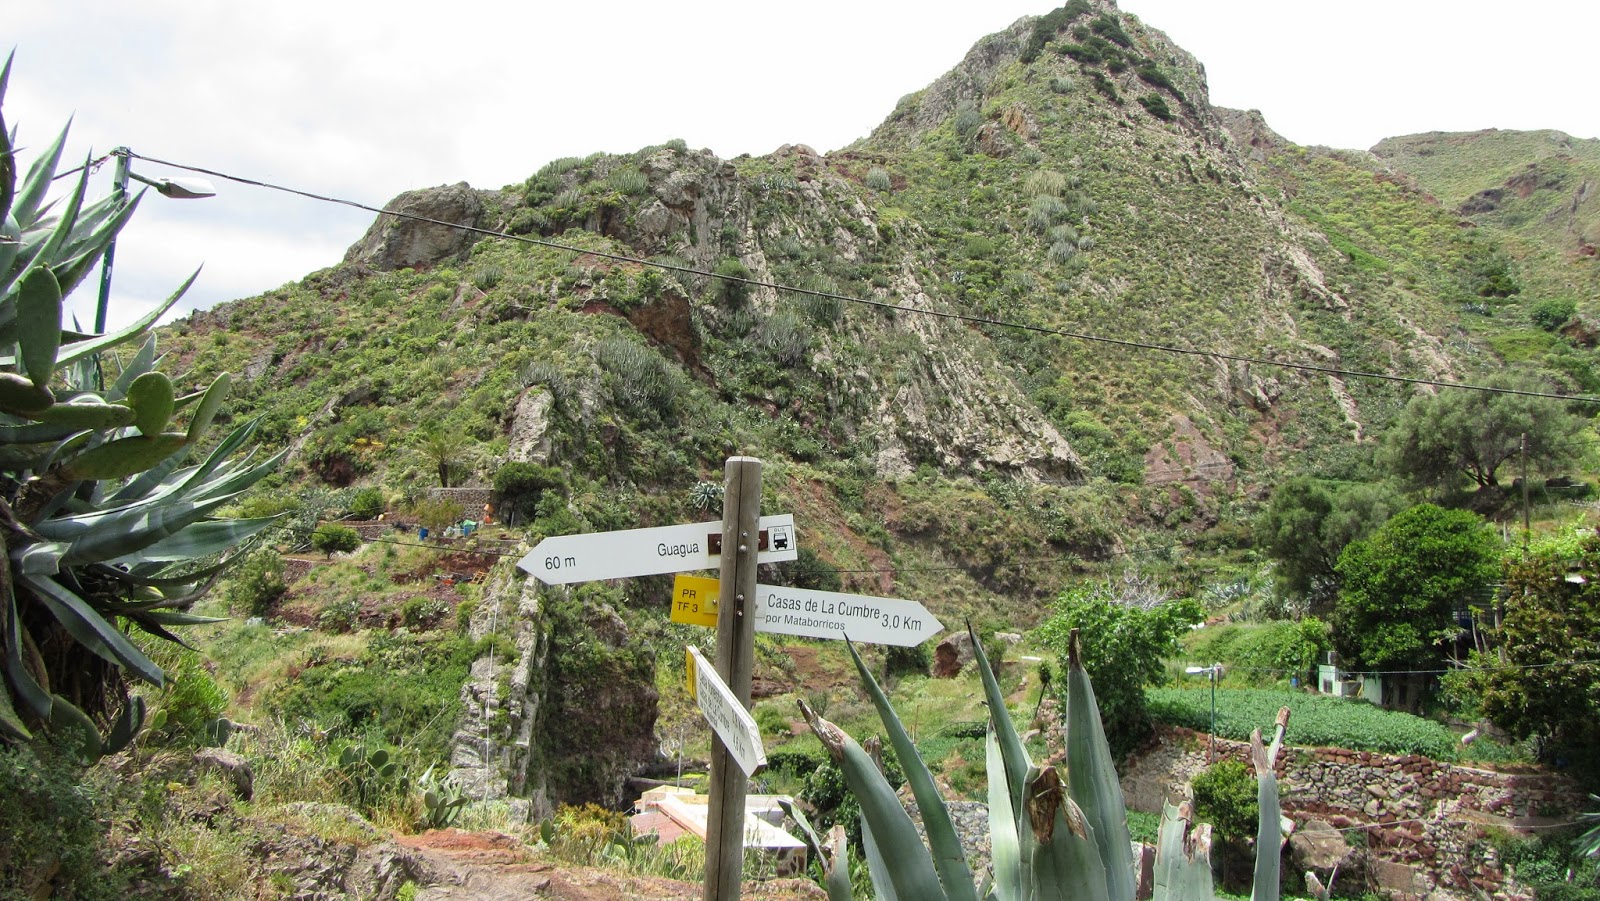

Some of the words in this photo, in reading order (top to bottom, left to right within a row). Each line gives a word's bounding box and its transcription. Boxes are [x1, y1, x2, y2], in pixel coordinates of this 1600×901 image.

[657, 542, 700, 558] Guagua
[545, 556, 561, 570] 60
[564, 556, 576, 568] m
[682, 588, 697, 599] PR
[677, 601, 690, 612] TF
[691, 603, 699, 613] 3
[767, 593, 801, 611] Casas
[805, 598, 818, 613] de
[821, 600, 835, 615] La
[838, 601, 881, 619] Cumbre
[765, 614, 782, 625] por
[784, 615, 846, 631] Mataborricos
[881, 613, 900, 630] 3,0
[903, 616, 922, 631] Km
